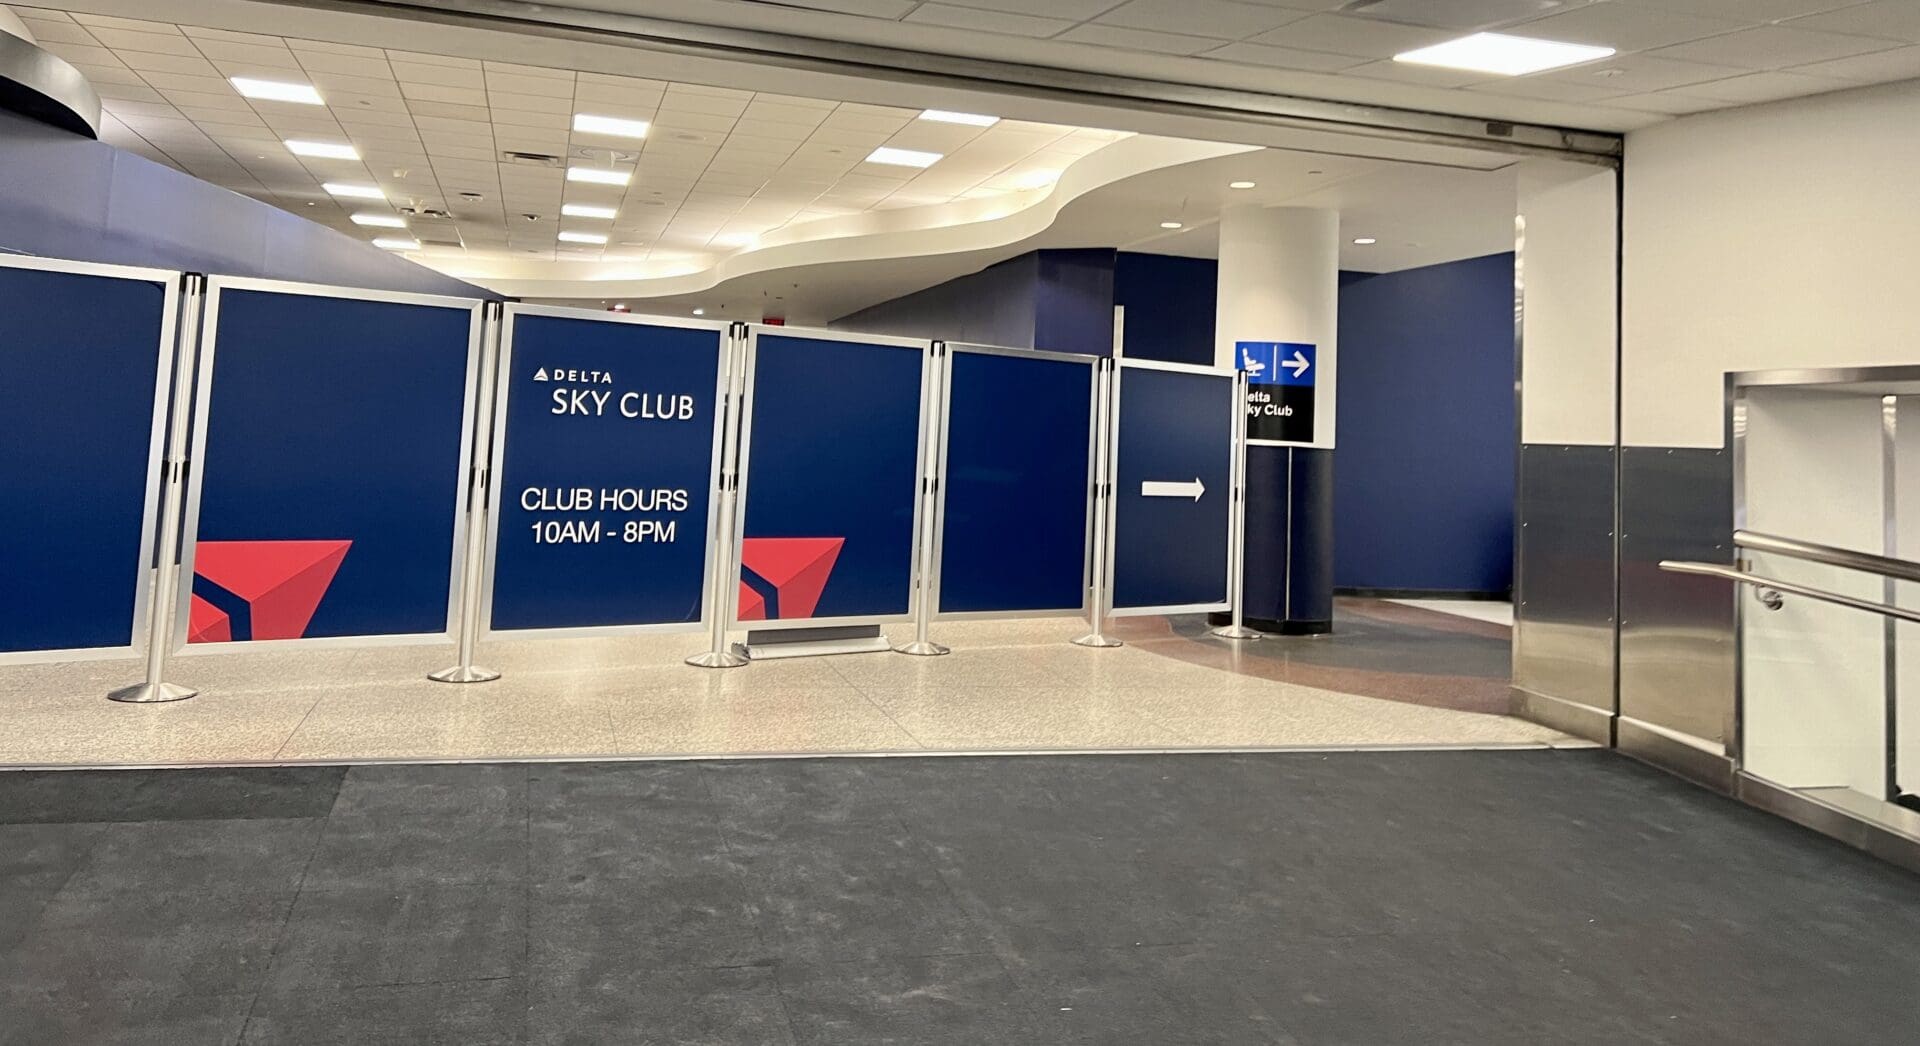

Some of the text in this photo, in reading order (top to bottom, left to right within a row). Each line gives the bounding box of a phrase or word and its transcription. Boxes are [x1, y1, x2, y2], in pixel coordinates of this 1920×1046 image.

[554, 369, 612, 383] DELTA
[551, 388, 694, 420] SKY CLUB
[1247, 391, 1270, 402] elta
[1247, 404, 1293, 417] ky Club
[521, 487, 688, 511] CLUB HOURS
[532, 521, 600, 543] 10AM
[623, 521, 676, 543] 8PM
